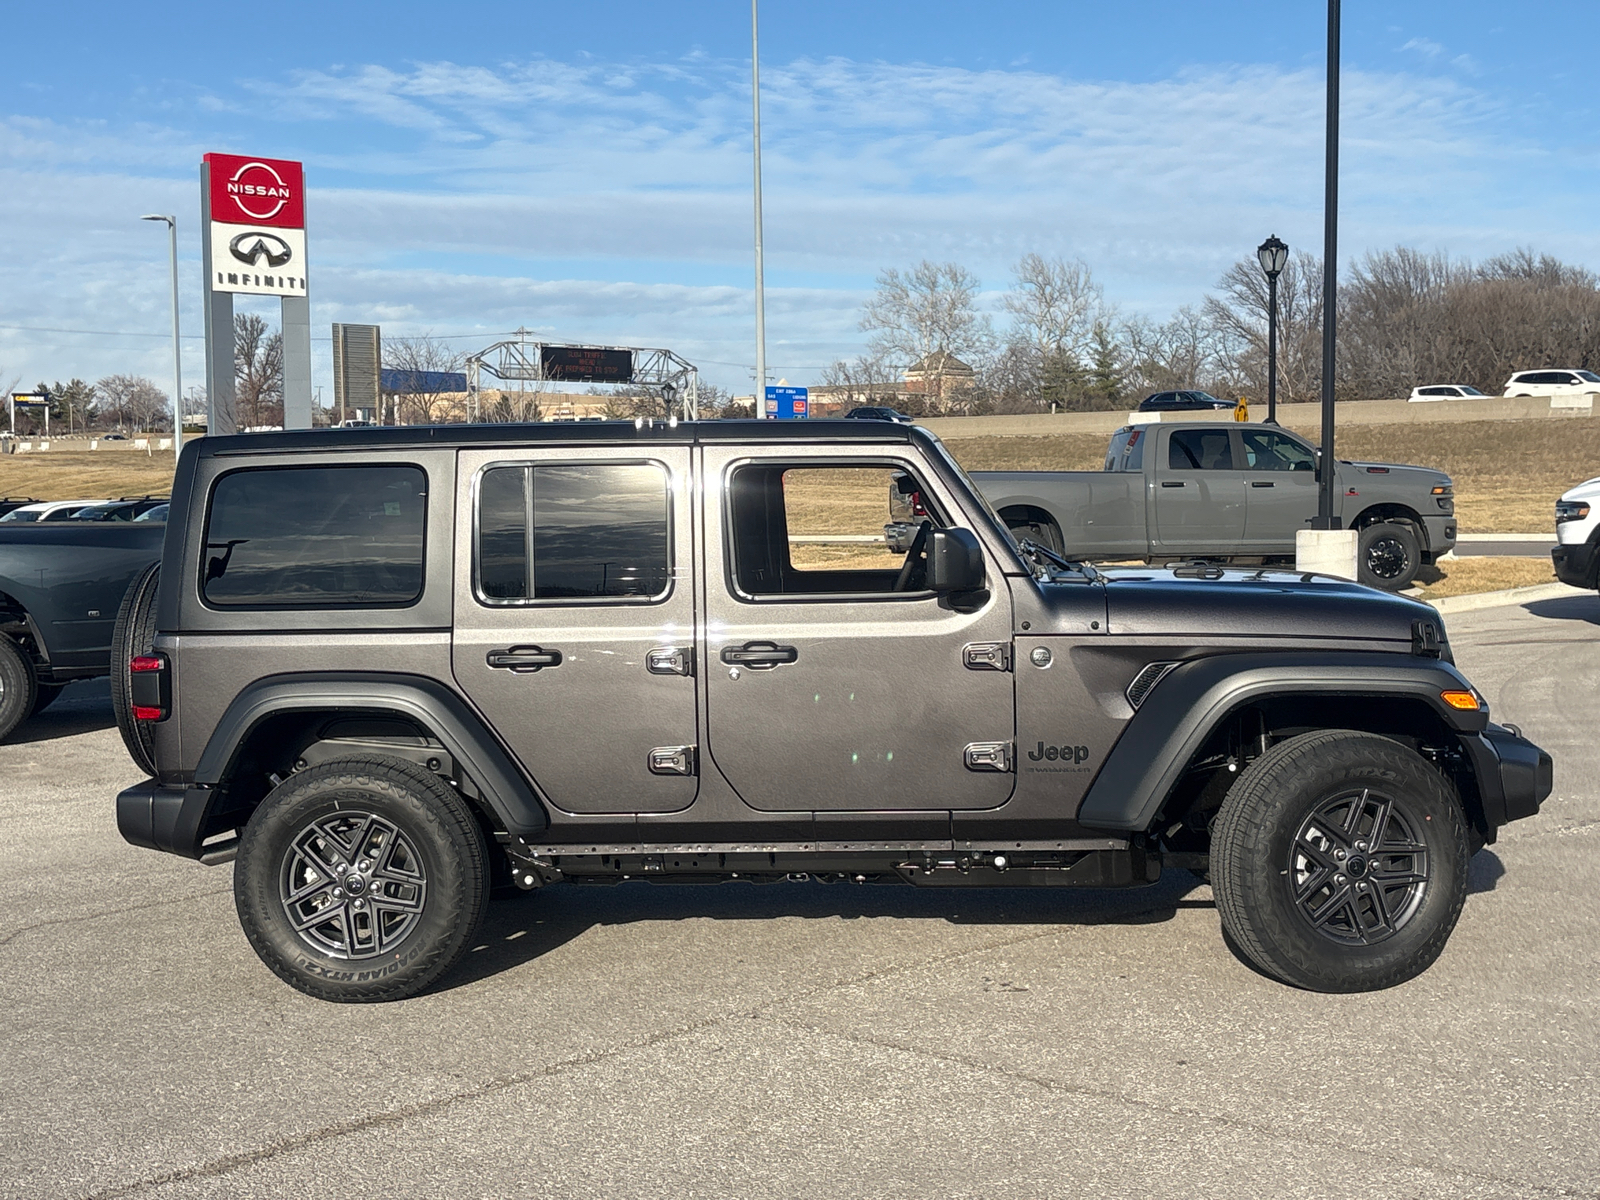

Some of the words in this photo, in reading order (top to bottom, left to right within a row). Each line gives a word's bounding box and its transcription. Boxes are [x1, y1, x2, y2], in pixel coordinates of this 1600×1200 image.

[227, 183, 290, 198] NISSAN
[217, 272, 305, 289] INFINITI
[1027, 741, 1089, 765] Jeep
